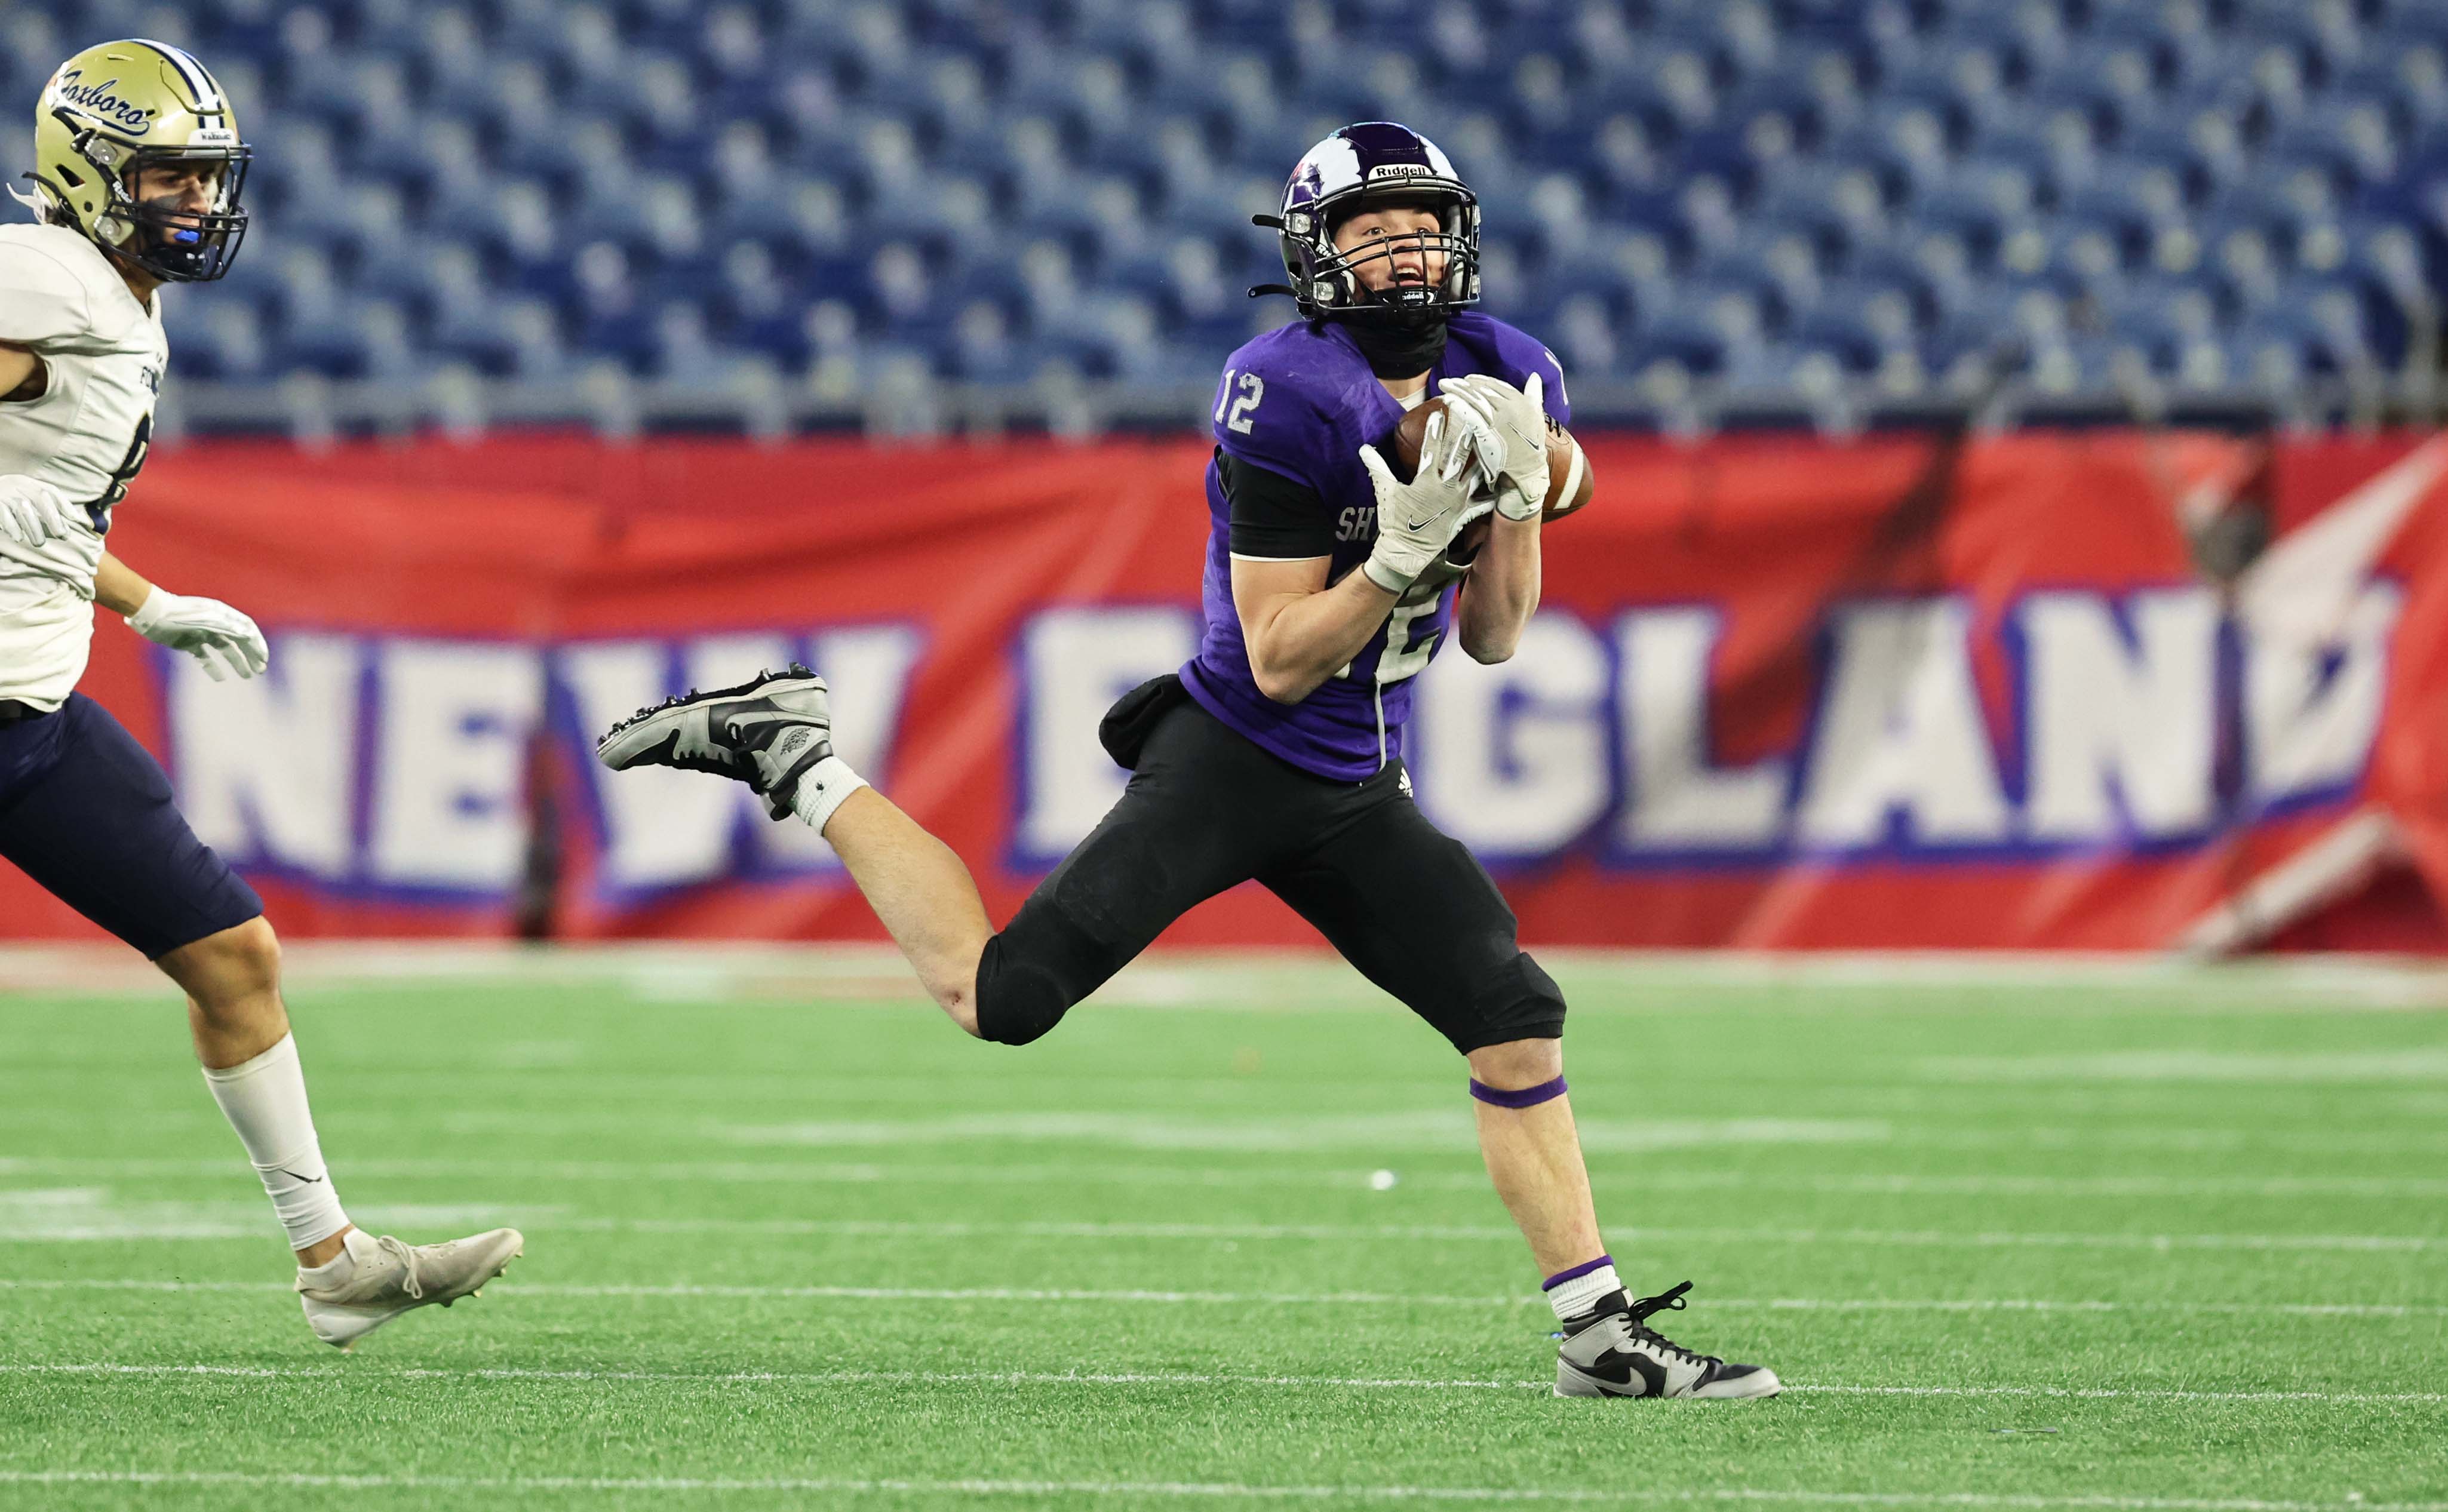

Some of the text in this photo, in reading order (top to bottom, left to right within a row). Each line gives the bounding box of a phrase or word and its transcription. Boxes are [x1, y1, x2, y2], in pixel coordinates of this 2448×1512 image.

[1376, 167, 1426, 177] Riddell
[1215, 369, 1264, 435] 12
[1335, 507, 1381, 542] SH
[155, 582, 2398, 896] NEW EGLAND
